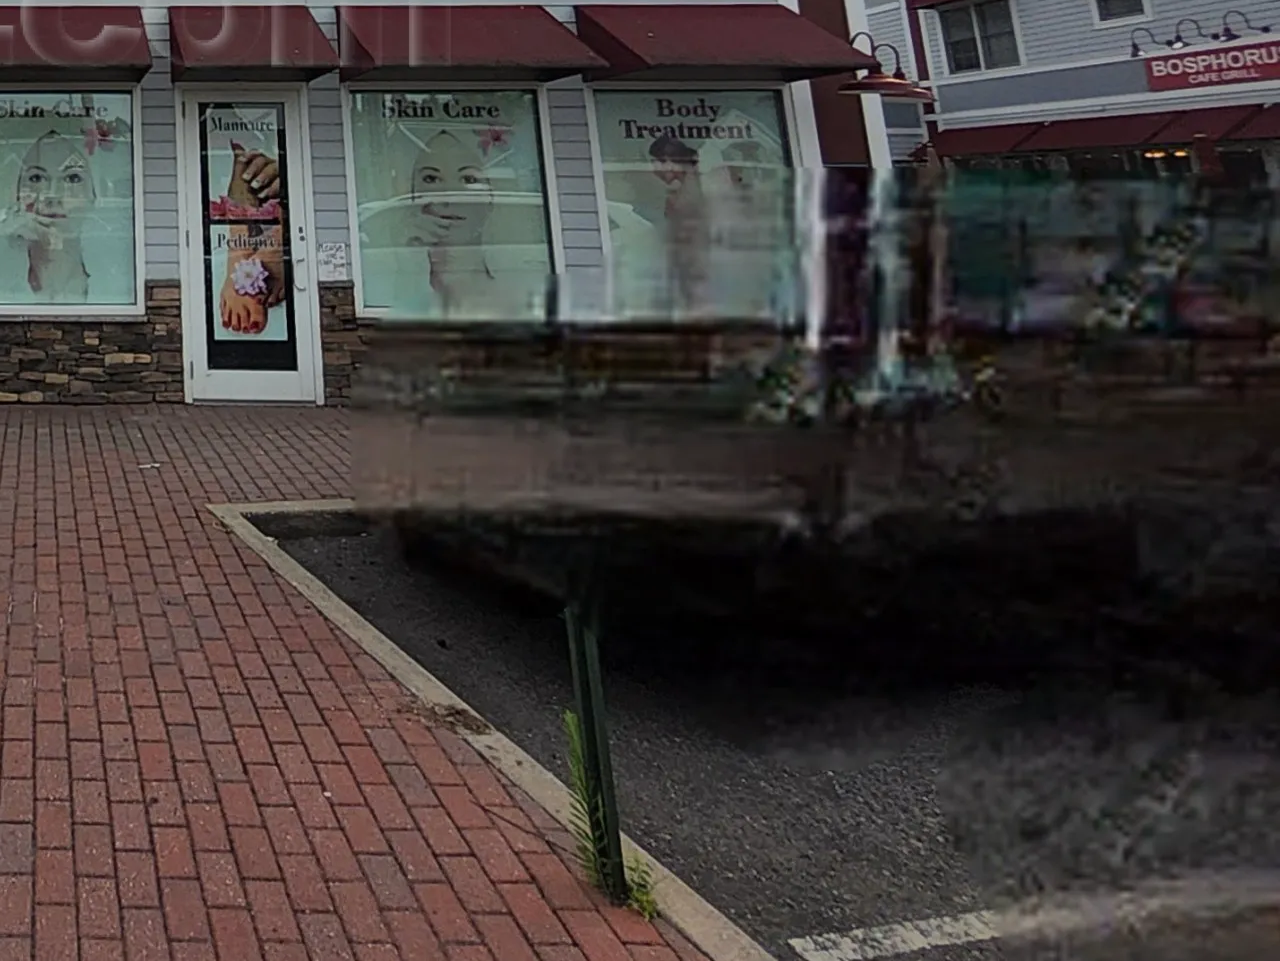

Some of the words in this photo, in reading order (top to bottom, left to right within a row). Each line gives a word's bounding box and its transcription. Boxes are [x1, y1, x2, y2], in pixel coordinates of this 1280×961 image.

[52, 97, 109, 119] Care
[381, 97, 435, 121] Skin
[441, 99, 501, 120] Care
[654, 97, 723, 124] Body
[210, 116, 275, 133] Manicure
[617, 117, 756, 142] Treatment
